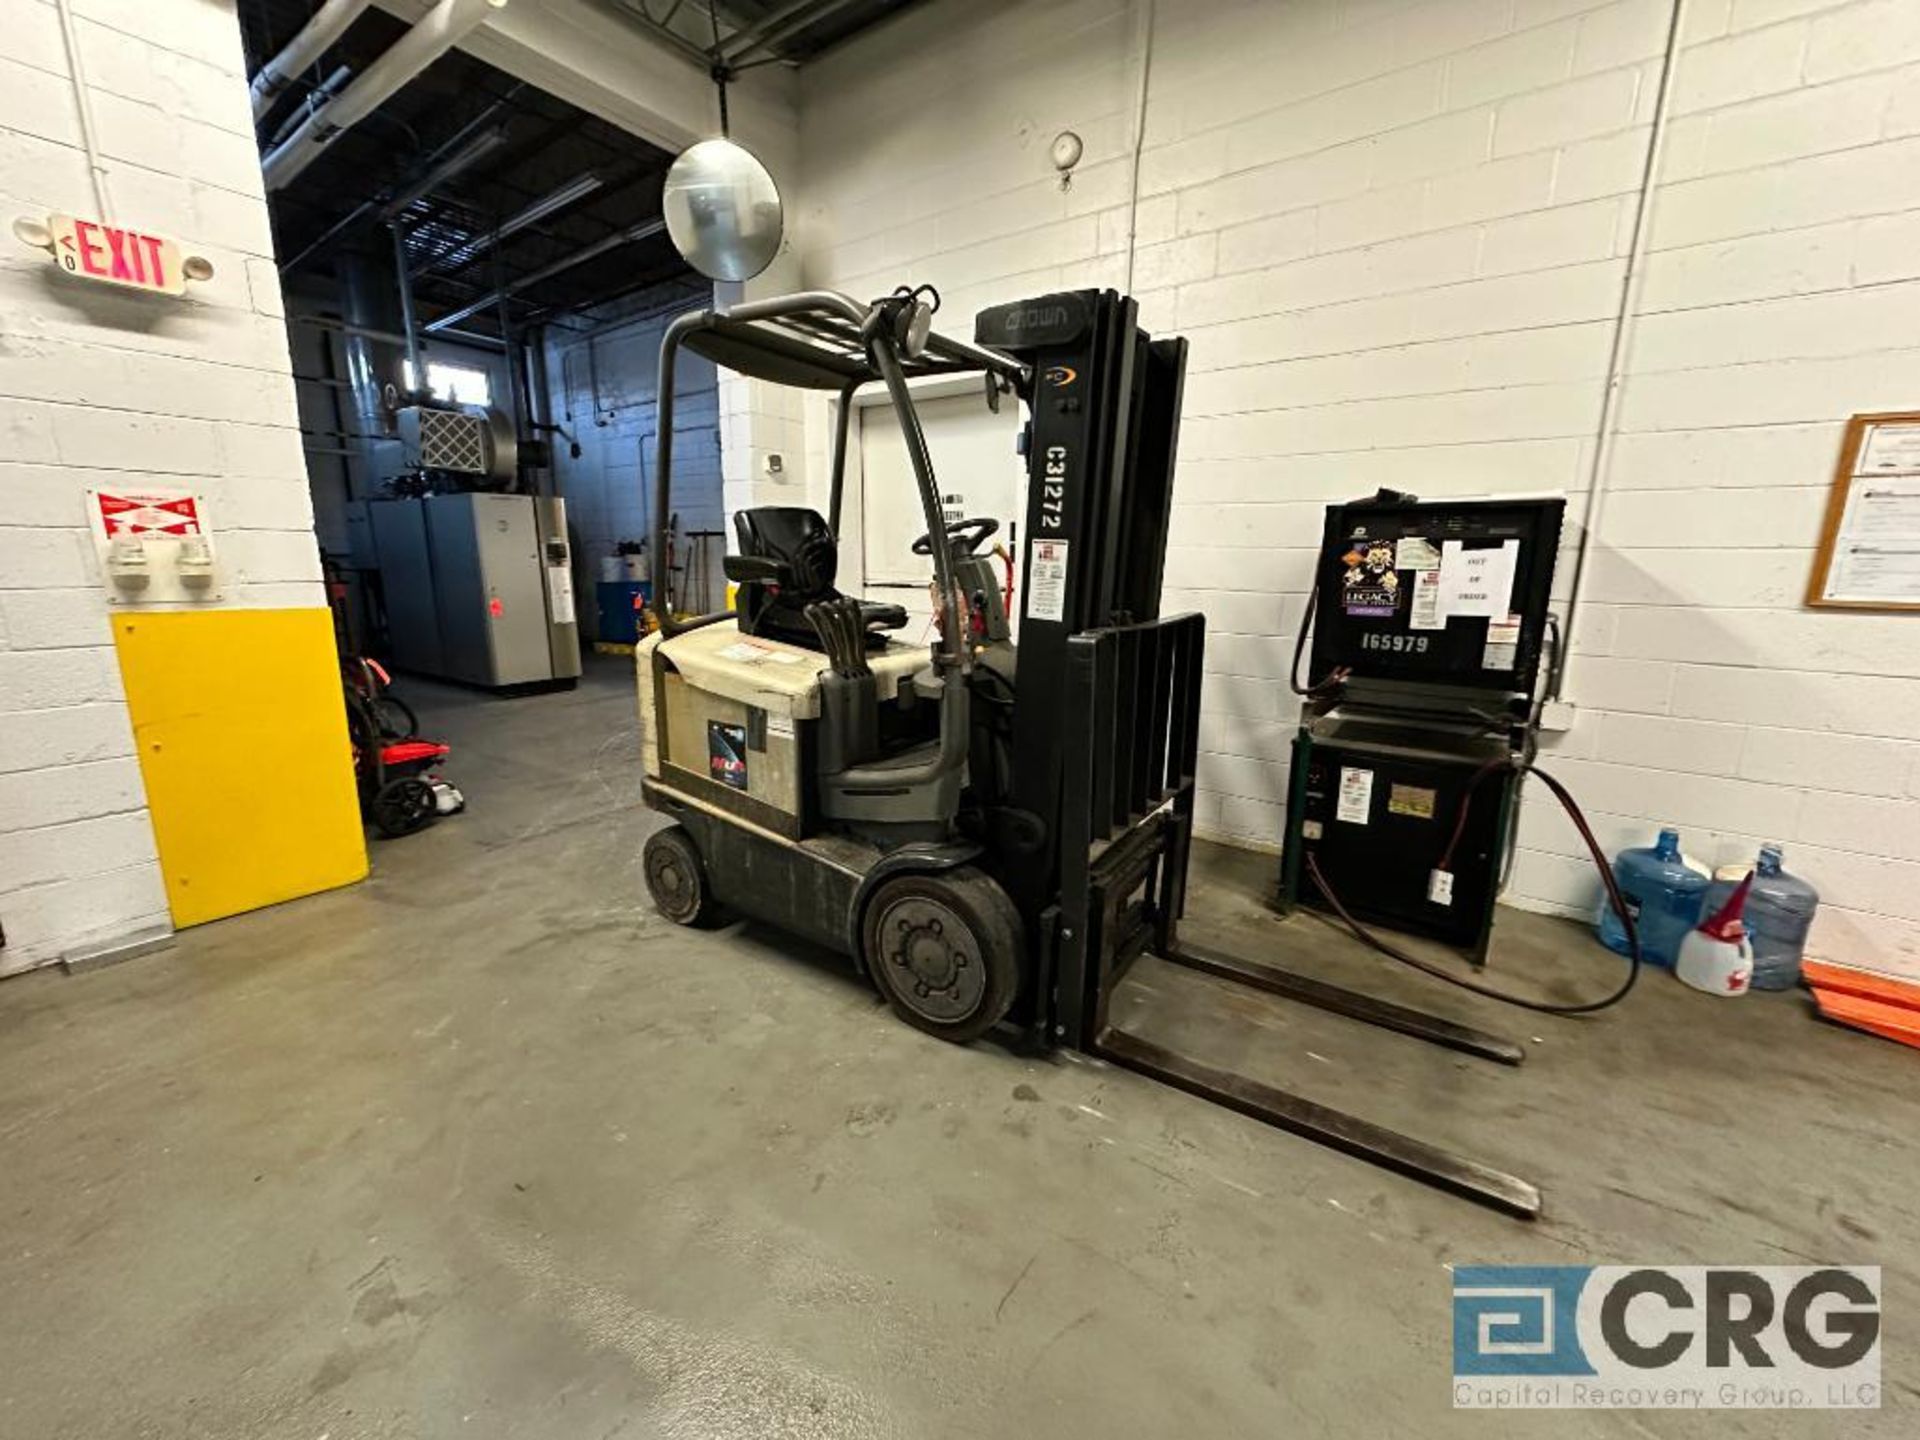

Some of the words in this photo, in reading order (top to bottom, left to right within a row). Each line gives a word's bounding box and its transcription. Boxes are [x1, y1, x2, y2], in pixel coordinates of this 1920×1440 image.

[75, 220, 164, 287] EXIT
[1042, 446, 1066, 528] C31272
[1346, 591, 1398, 602] LEGACY
[1362, 633, 1429, 653] 165979
